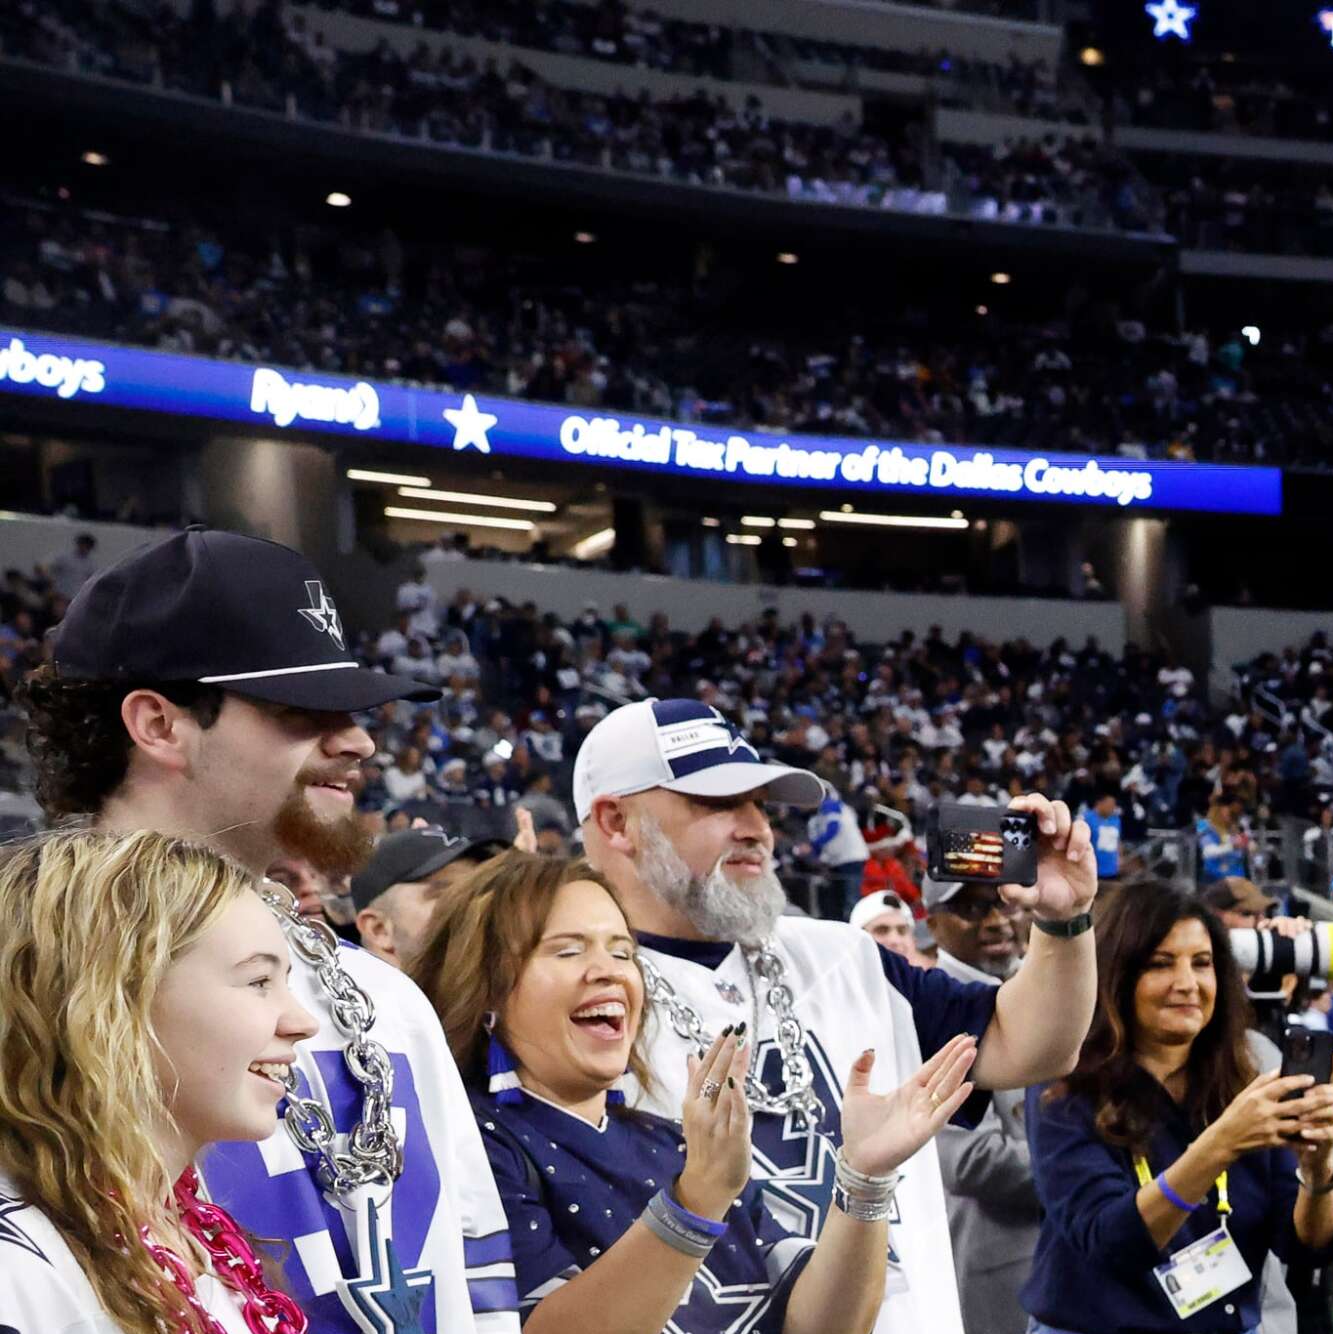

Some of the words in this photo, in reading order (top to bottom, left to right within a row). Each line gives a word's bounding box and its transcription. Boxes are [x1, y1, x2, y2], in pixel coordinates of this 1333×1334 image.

[560, 415, 672, 465] Official
[672, 429, 725, 471] Tax
[725, 436, 841, 481] Partner
[841, 445, 879, 482] of
[877, 446, 929, 486] the
[929, 451, 1022, 491] Dallas
[1024, 458, 1152, 505] Cowboys
